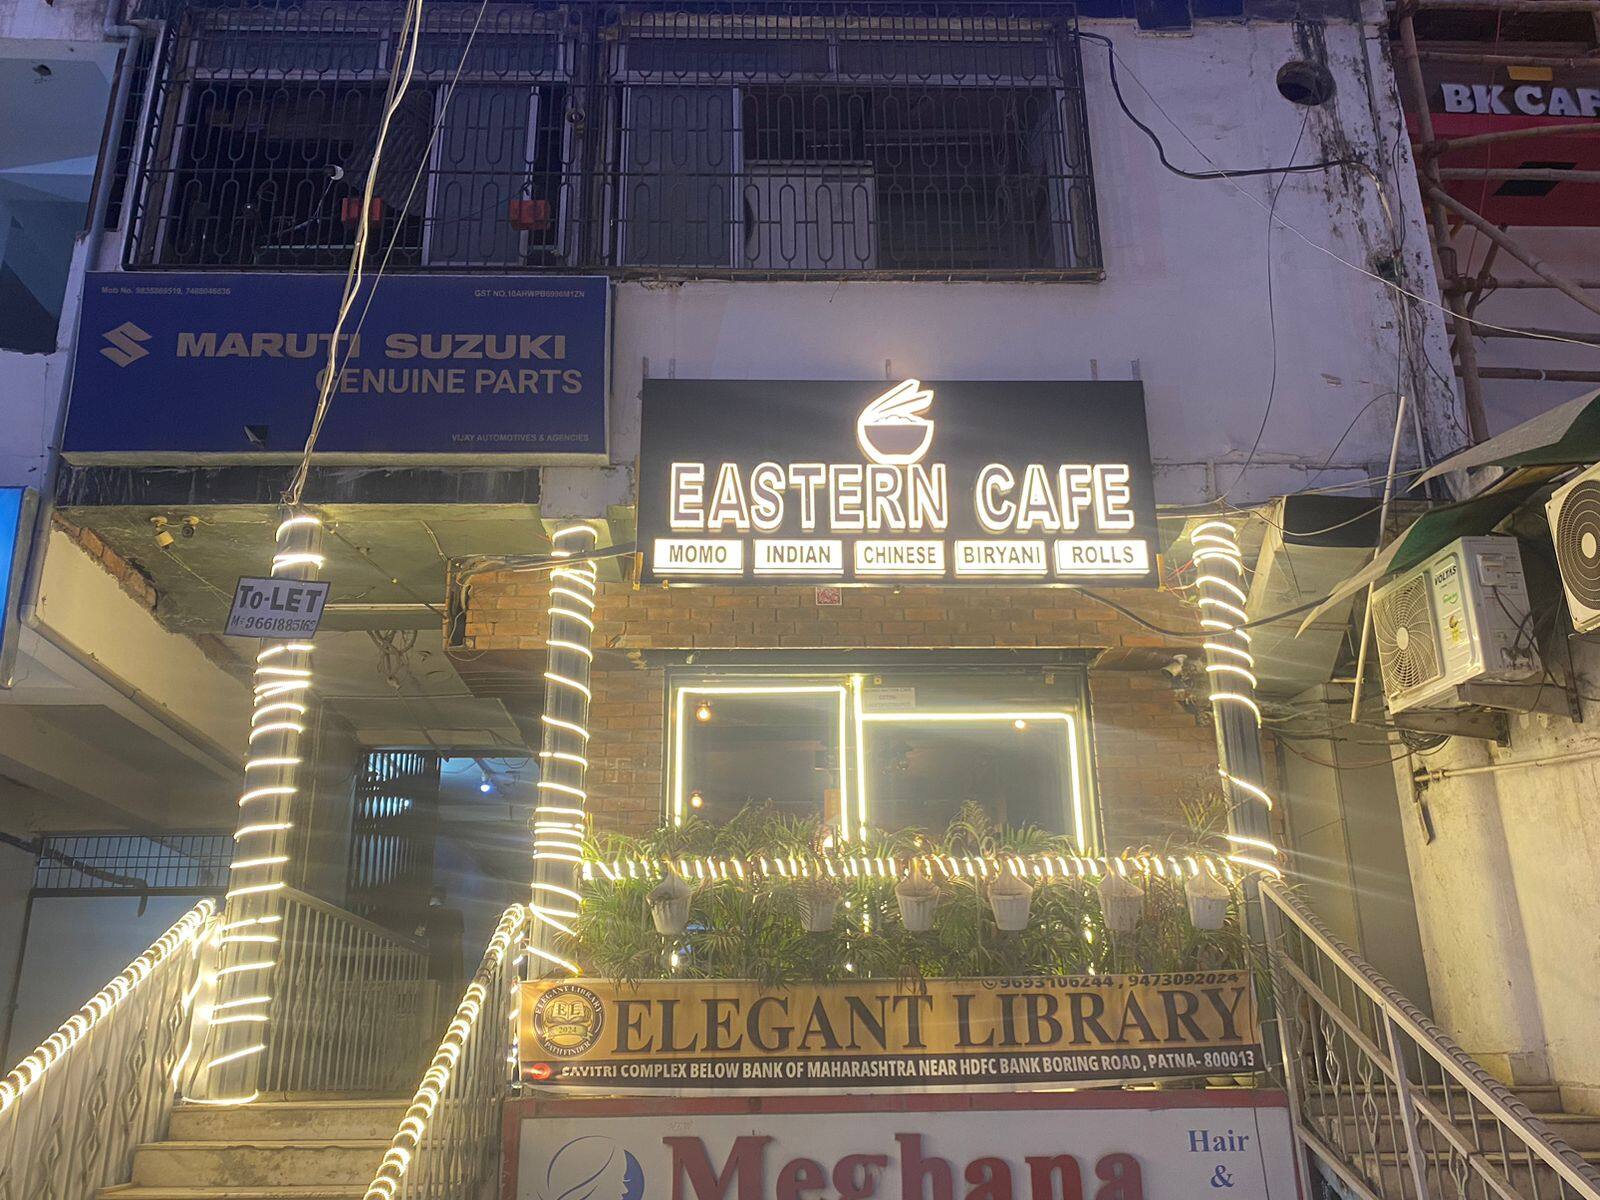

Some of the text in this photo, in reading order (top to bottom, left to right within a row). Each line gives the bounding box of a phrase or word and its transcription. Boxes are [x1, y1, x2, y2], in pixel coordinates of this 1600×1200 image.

[1441, 83, 1510, 115] BK
[474, 289, 491, 297] GST
[176, 332, 566, 360] MARUTI SUZUKI
[475, 369, 583, 394] PARTS
[476, 433, 537, 442] AUTOMOTIVES
[669, 461, 1135, 533] EASTERN CAFE
[669, 544, 727, 563] MOMO
[766, 545, 831, 563] INDIAN
[863, 546, 937, 564] CHINESE
[964, 546, 1041, 564] BIRYANI
[1072, 546, 1134, 564] ROLLS
[535, 985, 603, 1015] ELEGANT LIBRARY
[558, 1026, 577, 1034] 2024
[610, 986, 1247, 1054] ELEGANT LIBRARY
[543, 1040, 592, 1056] PATHFINDER
[620, 1064, 687, 1078] COMPLEX
[690, 1063, 739, 1078] BELOW
[743, 1062, 783, 1078] BANK
[786, 1062, 804, 1078] OF
[807, 1061, 915, 1078] MAHARASHTRA
[919, 1060, 957, 1076] NEAR
[960, 1059, 997, 1075] HDFC
[1000, 1057, 1040, 1074] BANK
[1044, 1056, 1099, 1073] BORING
[1204, 1050, 1254, 1068] 800013
[1187, 1129, 1249, 1152] Hair
[662, 1132, 1143, 1200] Meghana
[1210, 1164, 1235, 1188] &
